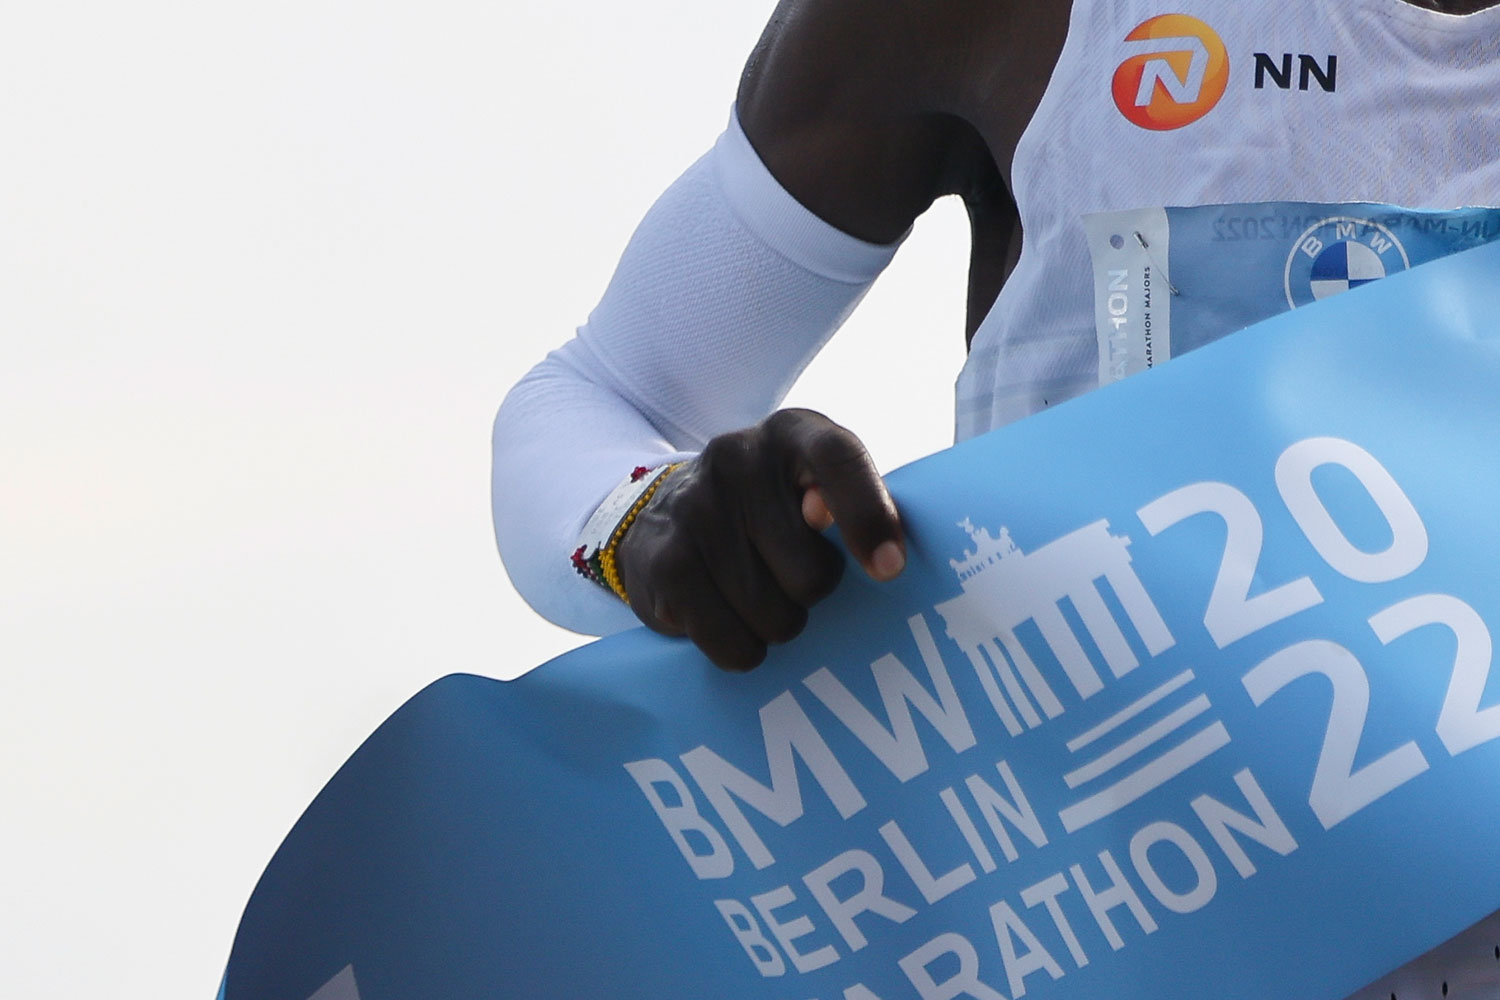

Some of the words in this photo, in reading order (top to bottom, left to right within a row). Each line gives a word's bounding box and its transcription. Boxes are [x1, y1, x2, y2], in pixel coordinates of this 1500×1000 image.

[1253, 52, 1338, 92] NN
[1301, 221, 1393, 259] BMW
[624, 614, 977, 880] BMW
[713, 759, 1048, 977] BERLIN
[808, 767, 1299, 1000] RATHON
